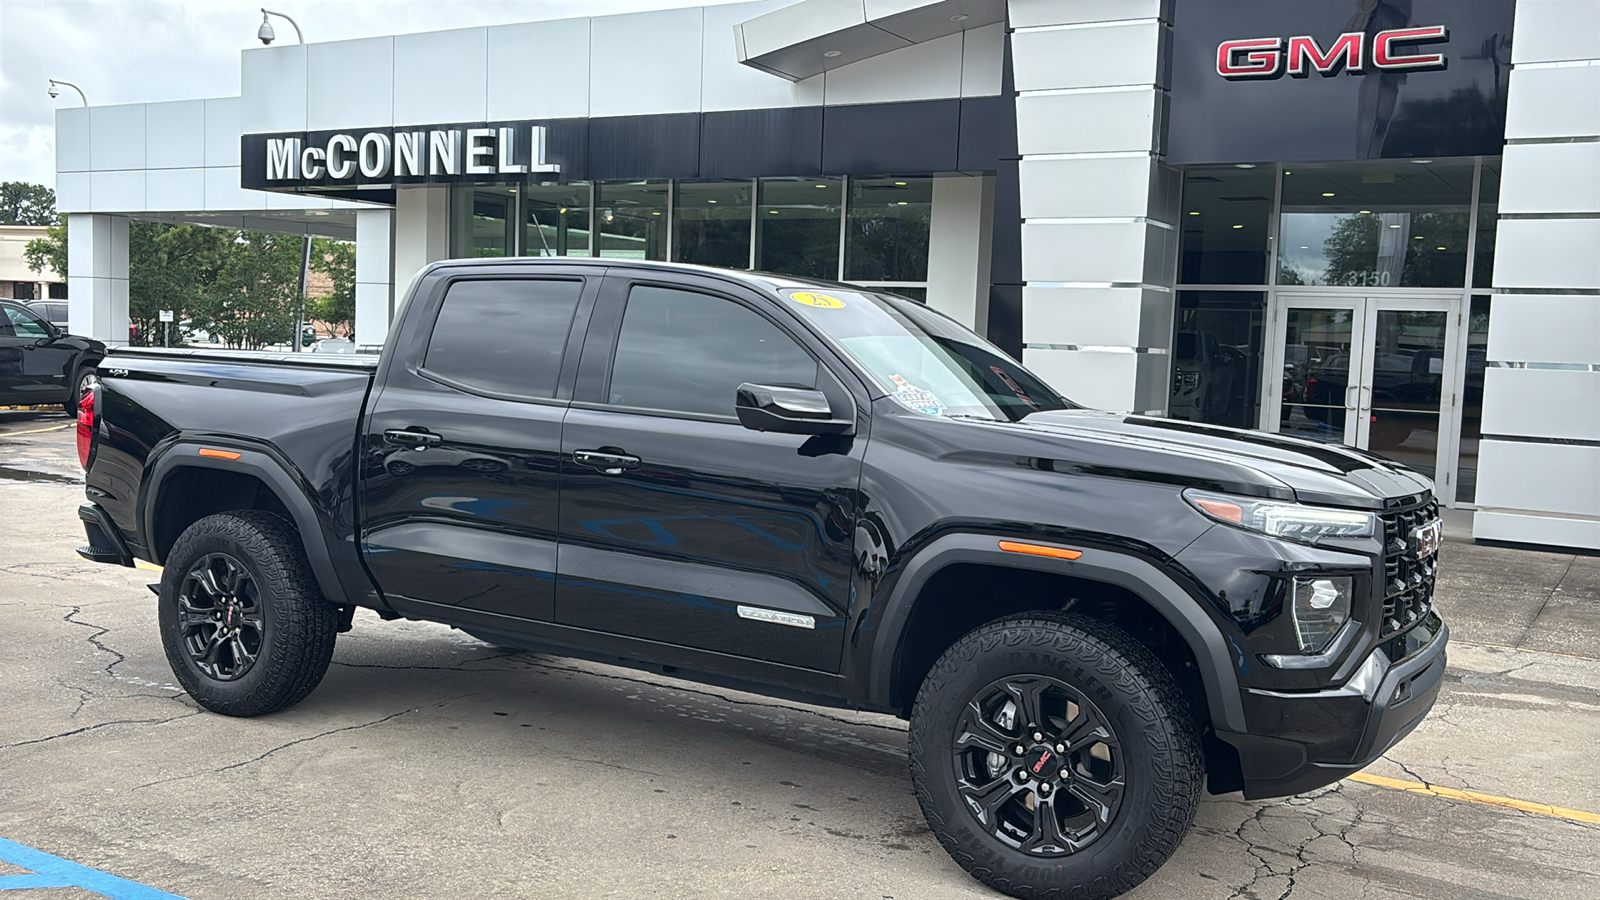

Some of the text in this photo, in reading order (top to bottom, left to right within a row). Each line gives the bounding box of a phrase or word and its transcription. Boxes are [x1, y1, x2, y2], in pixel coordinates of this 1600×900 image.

[1216, 25, 1448, 79] GMC
[266, 126, 560, 180] McCONNELL
[1348, 270, 1390, 286] 3150
[1032, 750, 1052, 773] GMC
